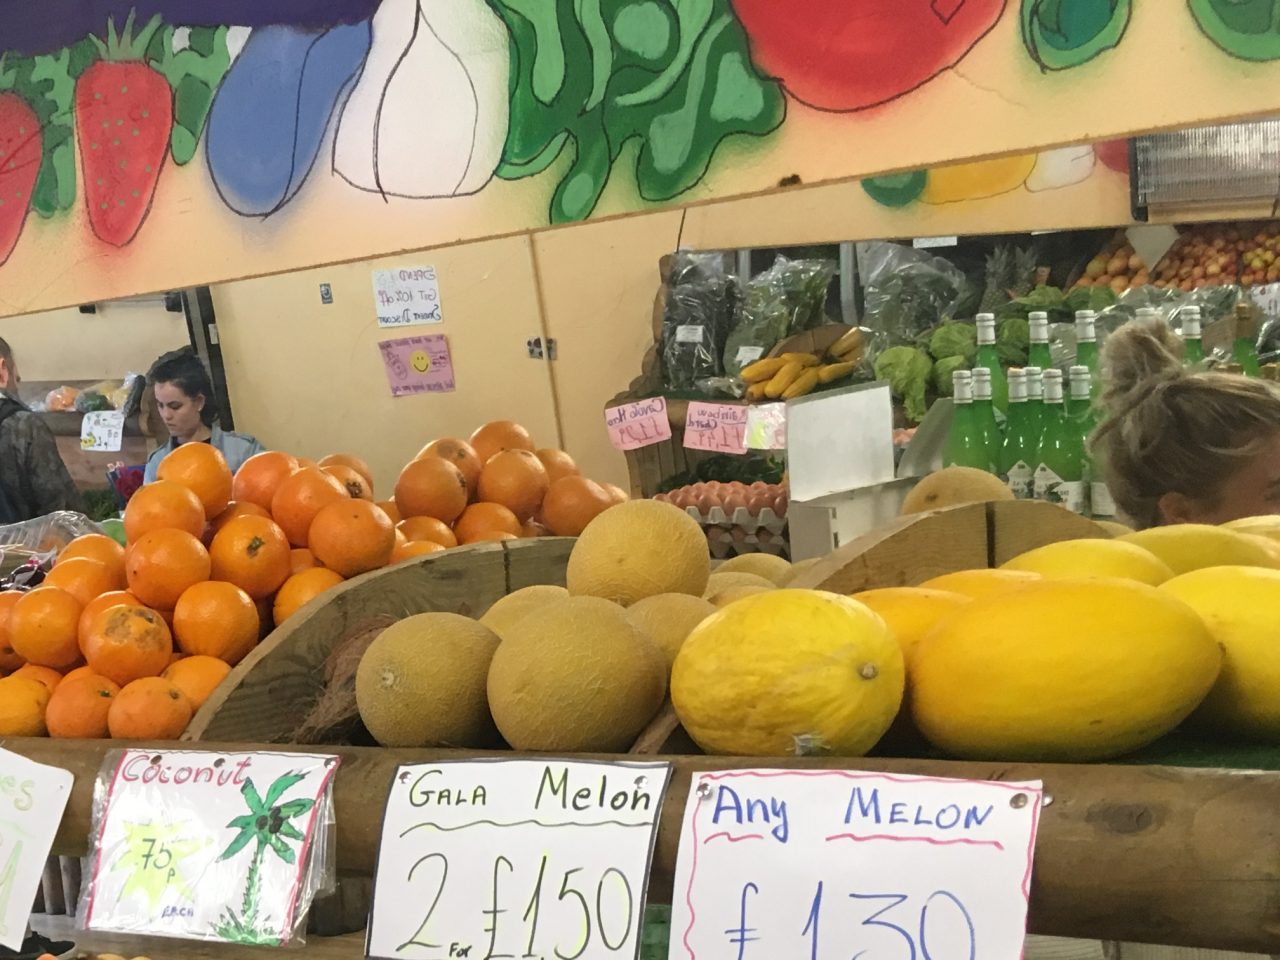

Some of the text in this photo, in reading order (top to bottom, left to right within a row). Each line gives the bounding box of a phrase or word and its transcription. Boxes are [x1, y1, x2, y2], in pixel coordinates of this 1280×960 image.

[121, 755, 253, 786] Coconut
[534, 766, 651, 812] Melon
[711, 784, 995, 844] Any MELON
[395, 852, 449, 952] 2
